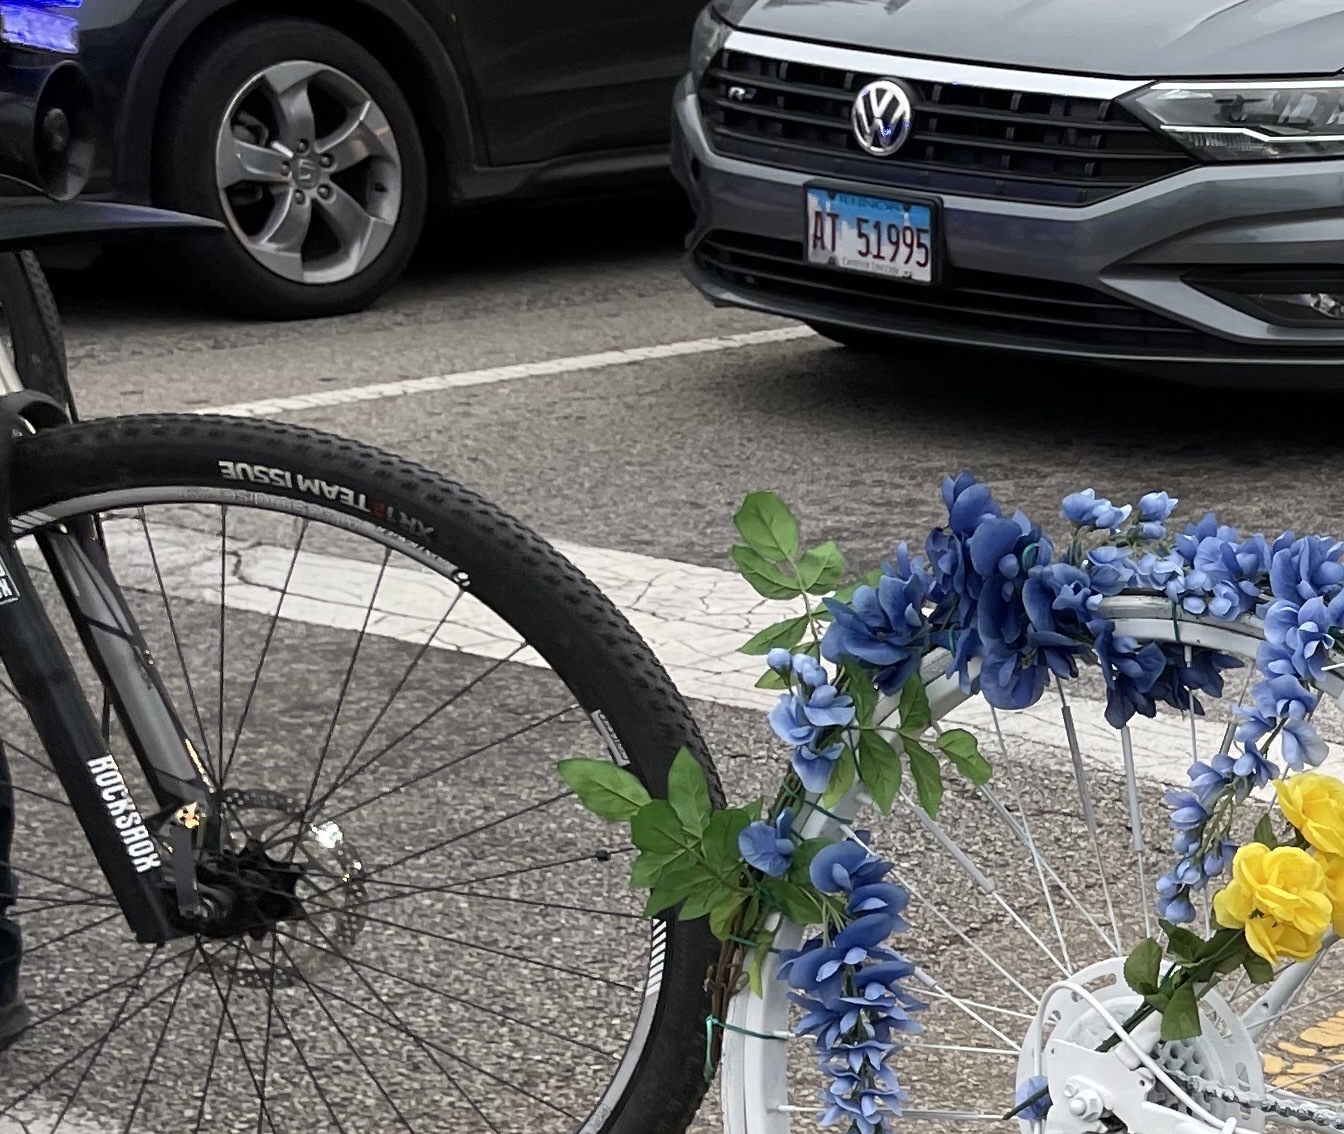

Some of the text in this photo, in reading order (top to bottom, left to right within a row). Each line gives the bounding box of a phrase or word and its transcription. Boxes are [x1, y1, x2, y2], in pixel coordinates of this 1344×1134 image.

[812, 210, 839, 253] AT
[856, 217, 929, 268] 51995
[218, 460, 292, 488] ISSUE
[297, 474, 372, 513] TEAM
[87, 754, 162, 873] ROCKSHOX
